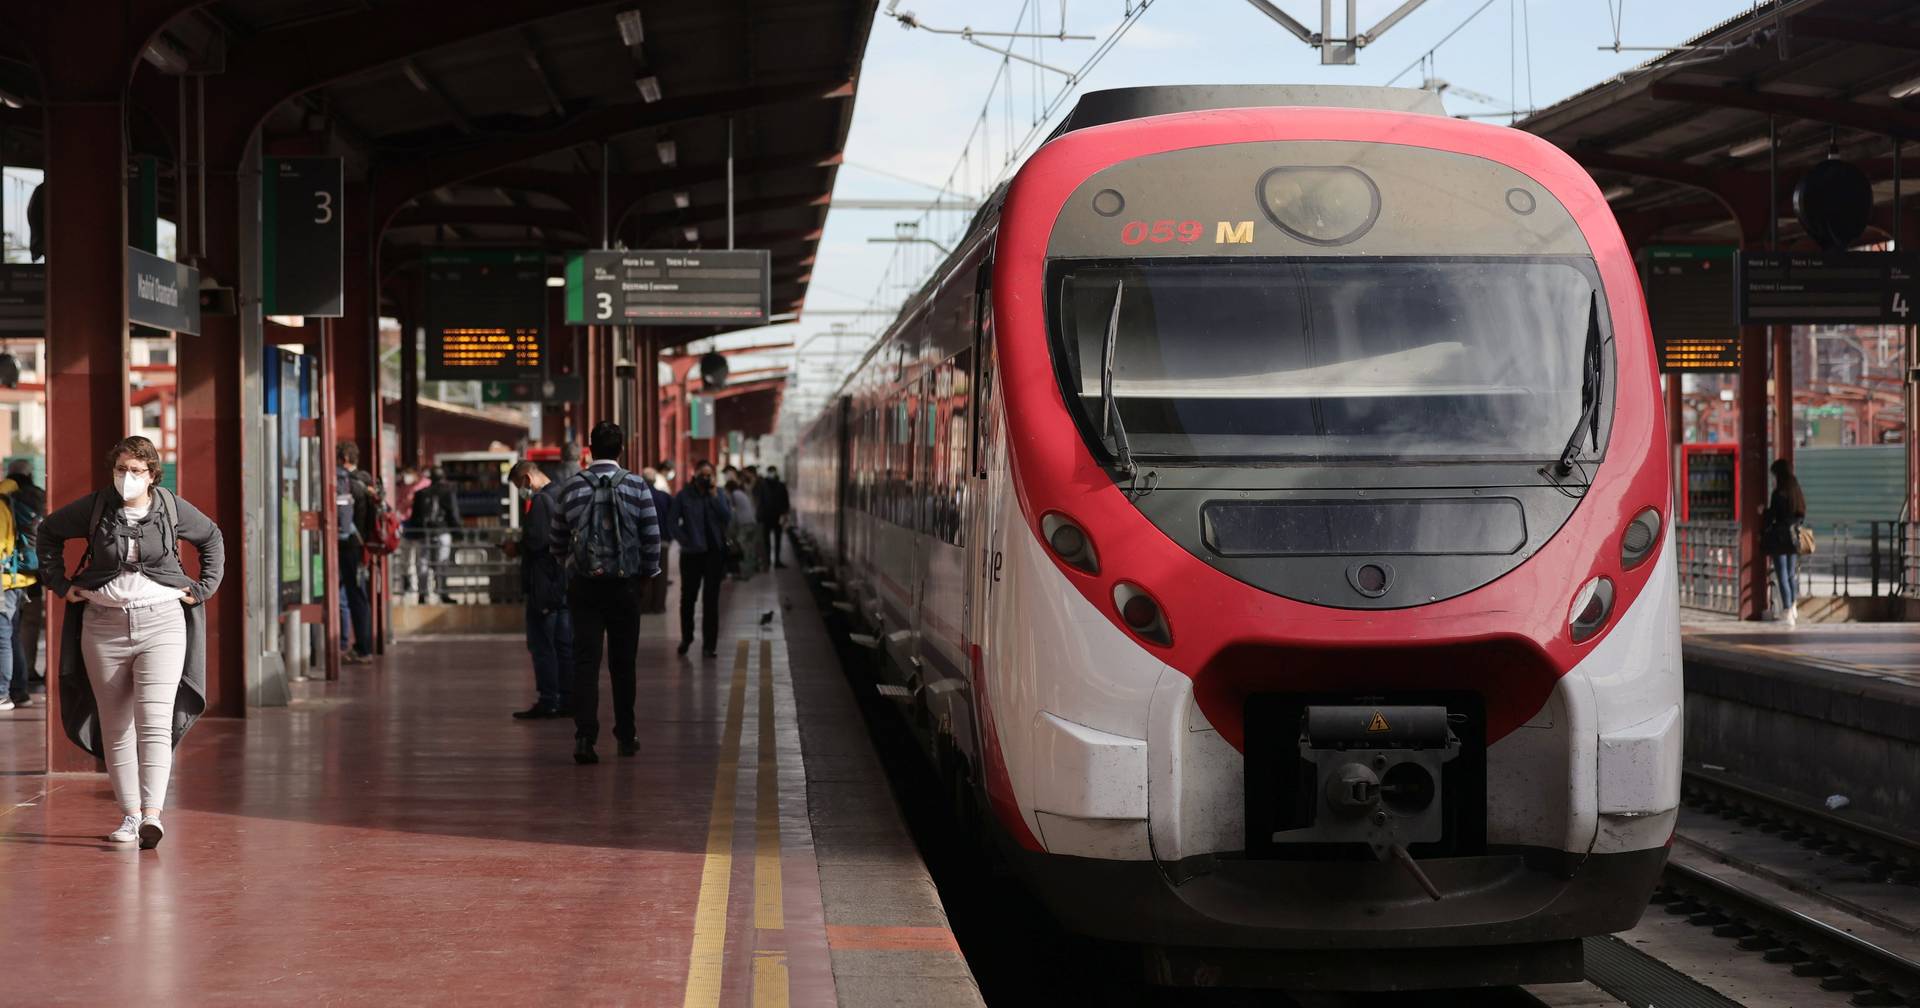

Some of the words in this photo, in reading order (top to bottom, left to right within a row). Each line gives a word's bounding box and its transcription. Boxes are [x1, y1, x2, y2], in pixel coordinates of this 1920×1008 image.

[314, 190, 333, 224] 3
[1121, 219, 1204, 245] 059
[1215, 220, 1255, 244] M
[596, 292, 613, 319] 3
[1891, 292, 1909, 318] 4
